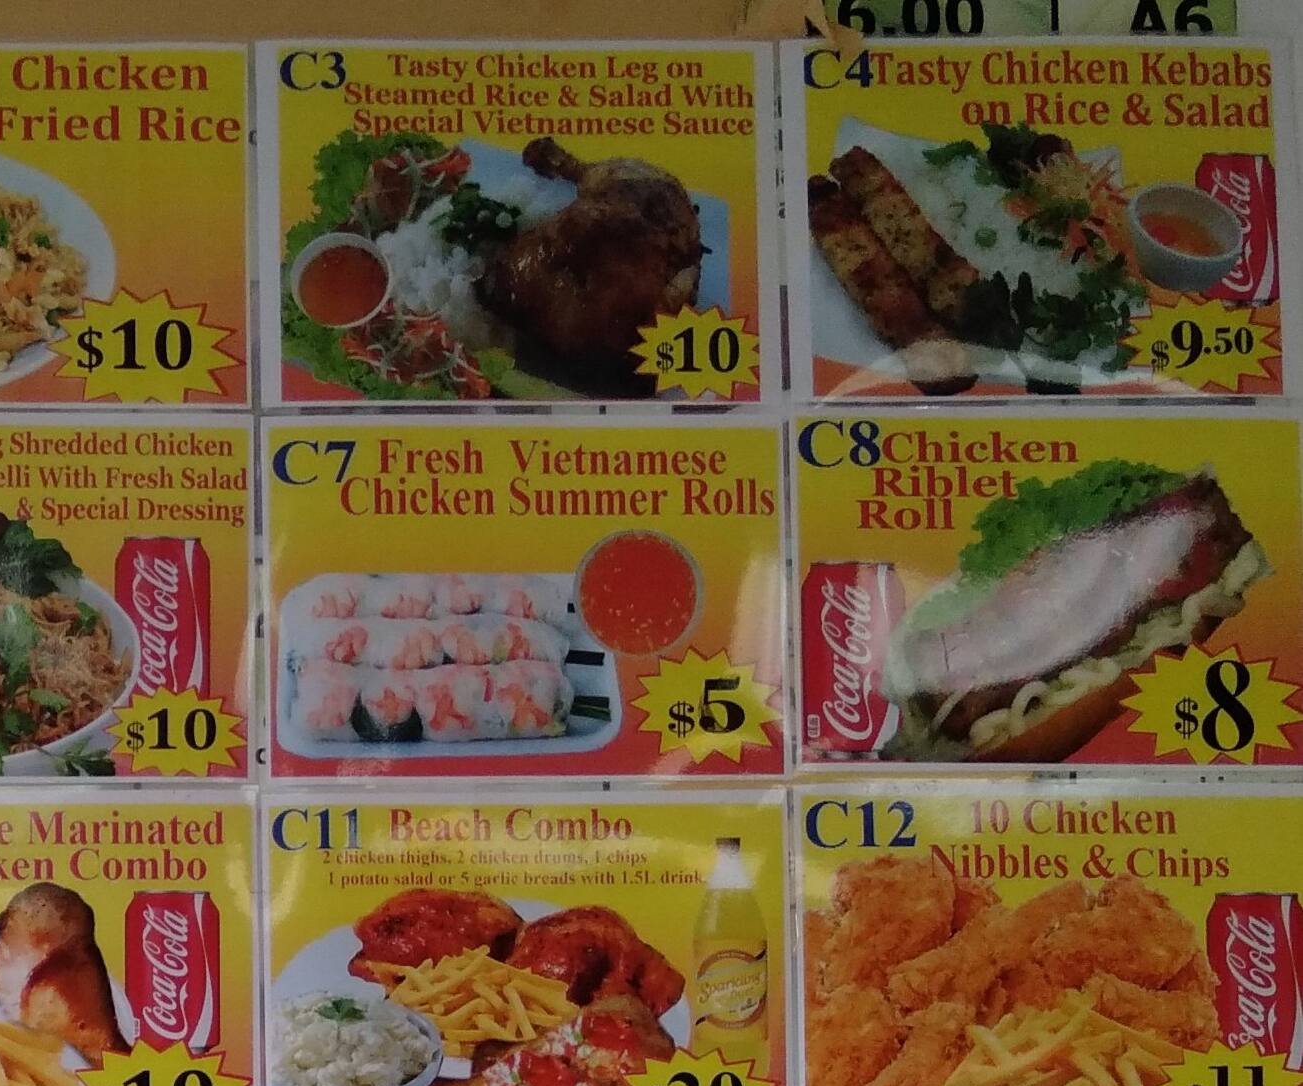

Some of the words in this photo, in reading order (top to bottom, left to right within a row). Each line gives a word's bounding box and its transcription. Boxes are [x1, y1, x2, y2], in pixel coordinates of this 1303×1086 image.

[279, 52, 346, 90] C3
[388, 54, 466, 82] Tasty
[476, 54, 595, 79] Chicken
[606, 57, 657, 84] Leg
[666, 61, 703, 79] on
[803, 49, 873, 90] C4
[353, 109, 463, 137] Special
[474, 111, 654, 135] Vietnamese
[663, 112, 752, 136] Sauce
[656, 327, 739, 373] $10
[1152, 321, 1254, 372] $9.50
[9, 433, 127, 457] Shredded
[135, 433, 232, 457] Chicken
[378, 440, 483, 474] Fresh
[509, 440, 726, 475] Vietnamese
[798, 420, 881, 468] C8
[40, 467, 98, 489] With
[105, 468, 173, 490] Fresh
[181, 469, 247, 492] Salad
[272, 441, 355, 485] C7
[340, 476, 495, 516] Chicken
[509, 478, 667, 516] Summer
[682, 479, 775, 516] Rolls
[873, 466, 1017, 498] Riblet
[16, 499, 34, 520] &
[41, 497, 128, 525] Special
[136, 499, 244, 528] Dressing
[857, 499, 955, 530] Roll
[668, 676, 745, 738] $5
[127, 709, 216, 751] $10
[28, 811, 224, 846] Marinated
[272, 808, 362, 851] C11
[389, 808, 491, 842] Beach
[506, 808, 633, 842] Combo
[805, 801, 917, 850] C12
[323, 851, 331, 864] 2
[336, 850, 394, 864] chicken
[458, 851, 465, 864] 2
[470, 850, 528, 864] chicken
[608, 851, 647, 866] chips
[928, 844, 1068, 879] Nibbles
[1082, 846, 1115, 879] &
[1127, 848, 1229, 886] Chips
[329, 873, 334, 885] 1
[341, 873, 389, 889] potato
[394, 872, 434, 886] salad
[439, 875, 457, 885] or
[461, 873, 469, 885] 5
[474, 873, 519, 889] garlic
[524, 872, 575, 885] breads
[581, 872, 614, 886] with
